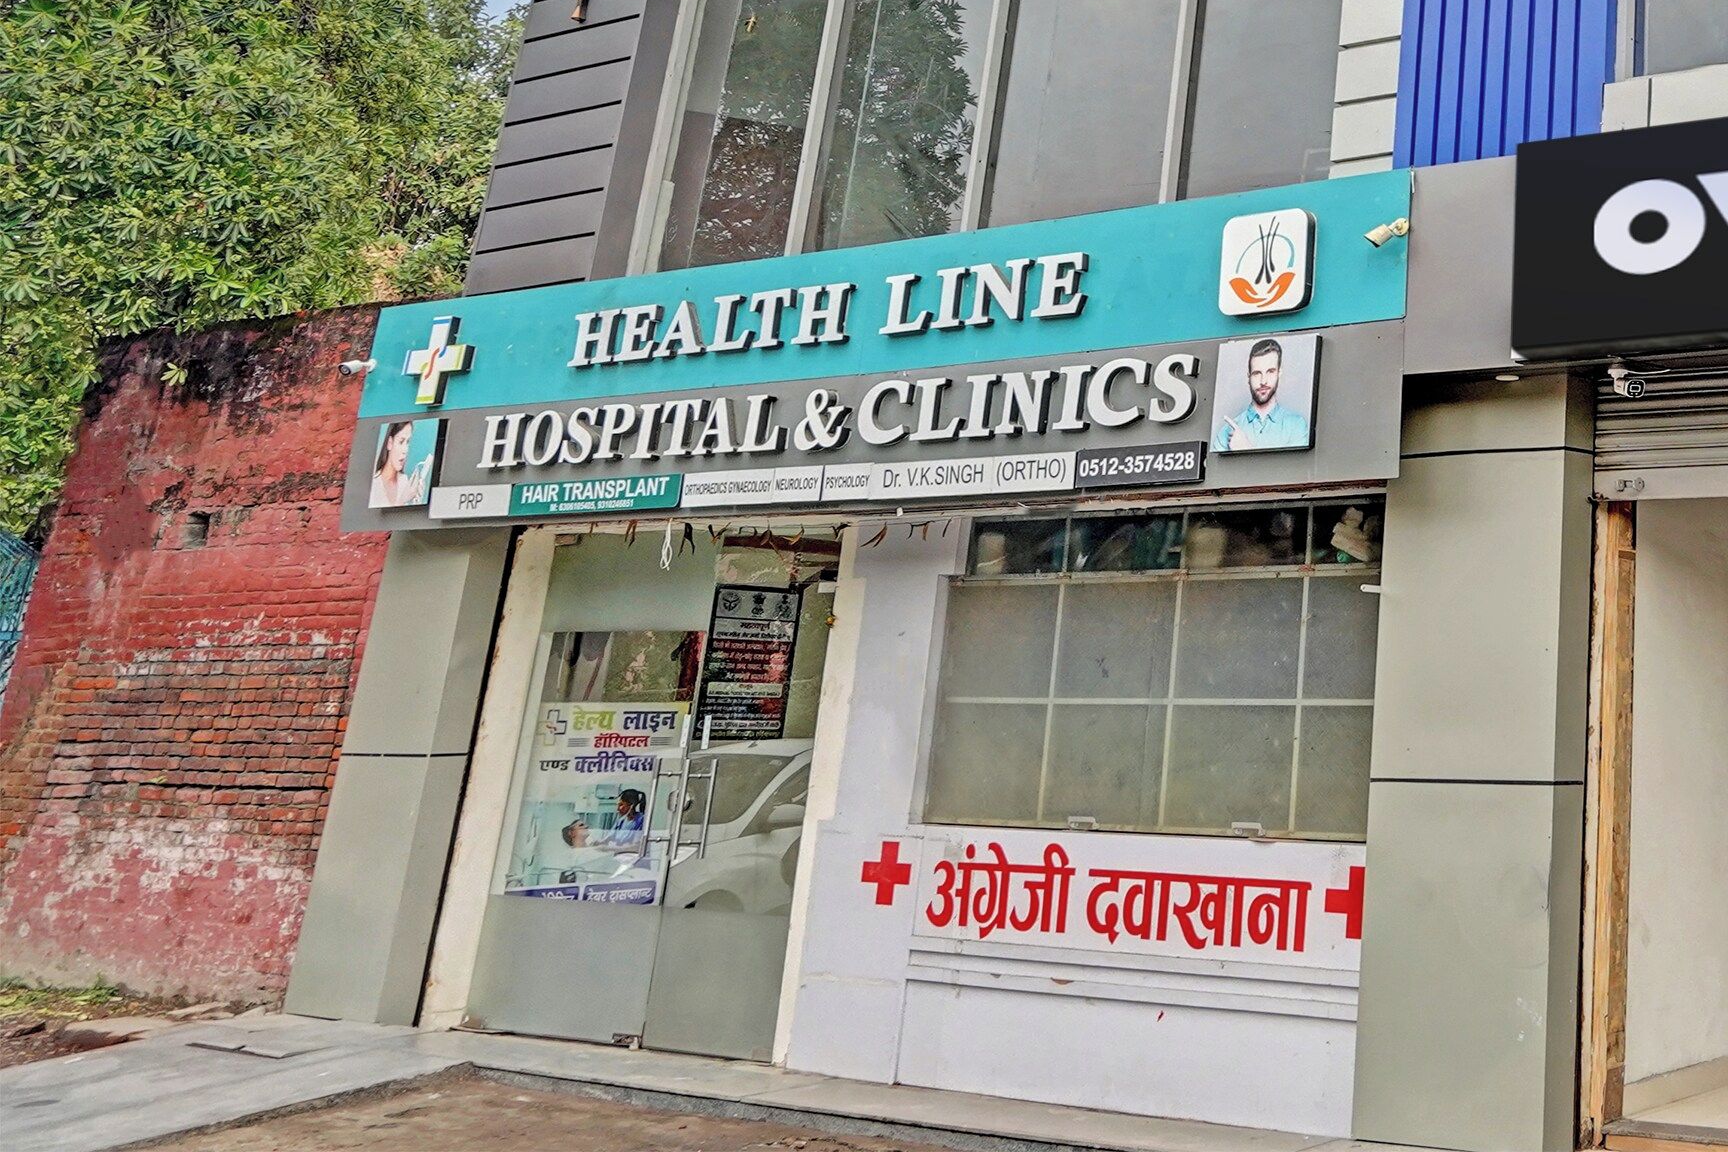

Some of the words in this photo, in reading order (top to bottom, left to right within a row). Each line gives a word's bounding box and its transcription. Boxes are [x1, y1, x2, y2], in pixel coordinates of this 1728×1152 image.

[567, 282, 857, 367] HEALTH
[879, 252, 1089, 337] LINE
[477, 393, 787, 470] HOSPITAL
[858, 352, 1201, 447] CLINICS
[882, 469, 901, 488] Dr.
[996, 458, 1067, 486] (ORTHO)
[1079, 451, 1195, 478] 0512-3574528
[521, 483, 560, 504] HAIR
[563, 476, 670, 502] TRANSPLANT
[684, 480, 728, 496] ORTHOPAEDICS
[727, 479, 772, 493] GYNAECOLOGY
[774, 477, 819, 491] NEUROLOGY
[825, 475, 870, 489] PSYCHOLOGY
[458, 492, 483, 510] PRP
[623, 710, 678, 733] लाइन
[925, 841, 1076, 940] अंग्रेजी
[1086, 868, 1312, 953] दवाखाना
